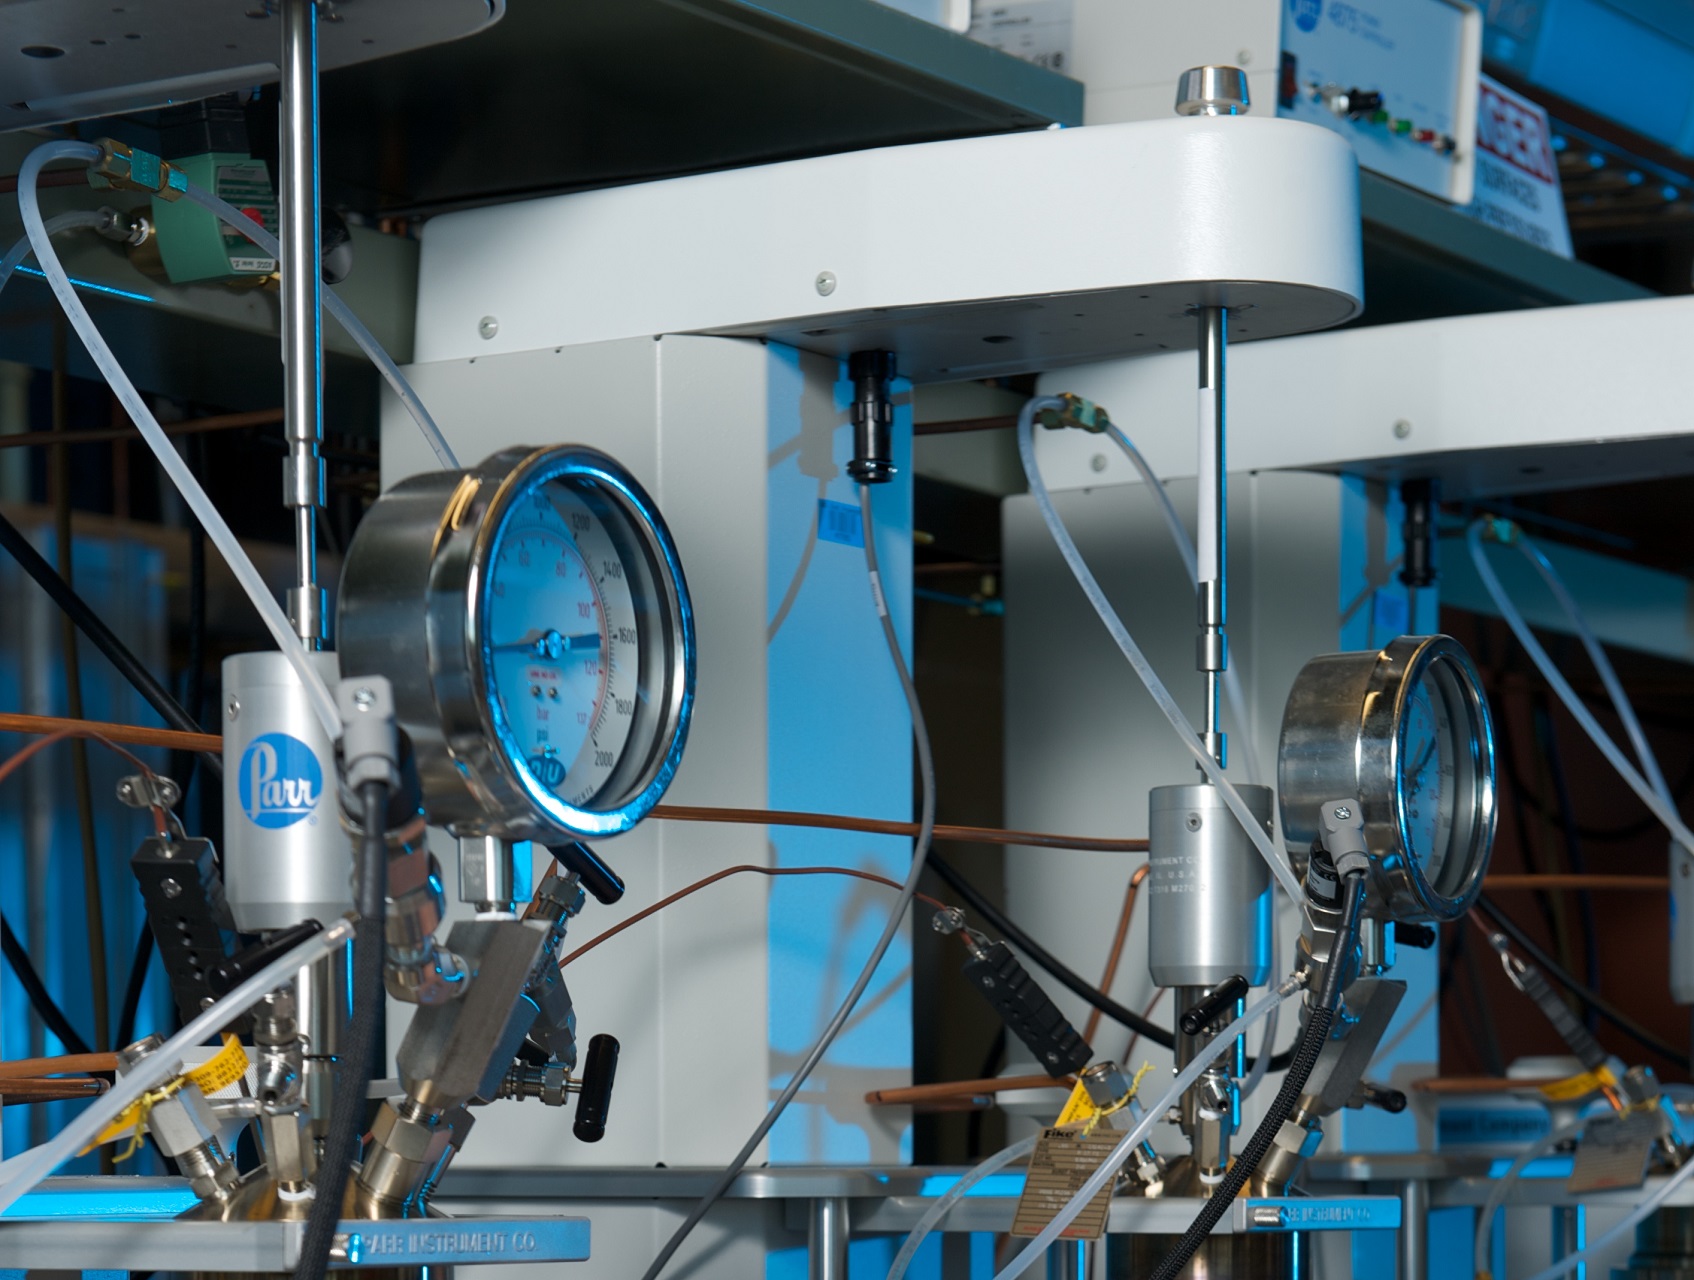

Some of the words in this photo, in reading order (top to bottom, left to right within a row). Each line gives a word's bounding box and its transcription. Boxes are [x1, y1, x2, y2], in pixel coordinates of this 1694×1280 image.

[571, 513, 590, 531] 1200
[602, 561, 622, 579] 1400
[577, 602, 590, 618] 100
[618, 628, 636, 644] 1600
[584, 660, 598, 675] 120
[536, 705, 549, 721] bar
[615, 699, 633, 716] 1800
[536, 728, 549, 743] psi
[594, 750, 614, 767] 2000
[248, 740, 318, 820] Parr
[1043, 1129, 1075, 1140] Fike
[408, 1231, 509, 1254] INSTRUMENT
